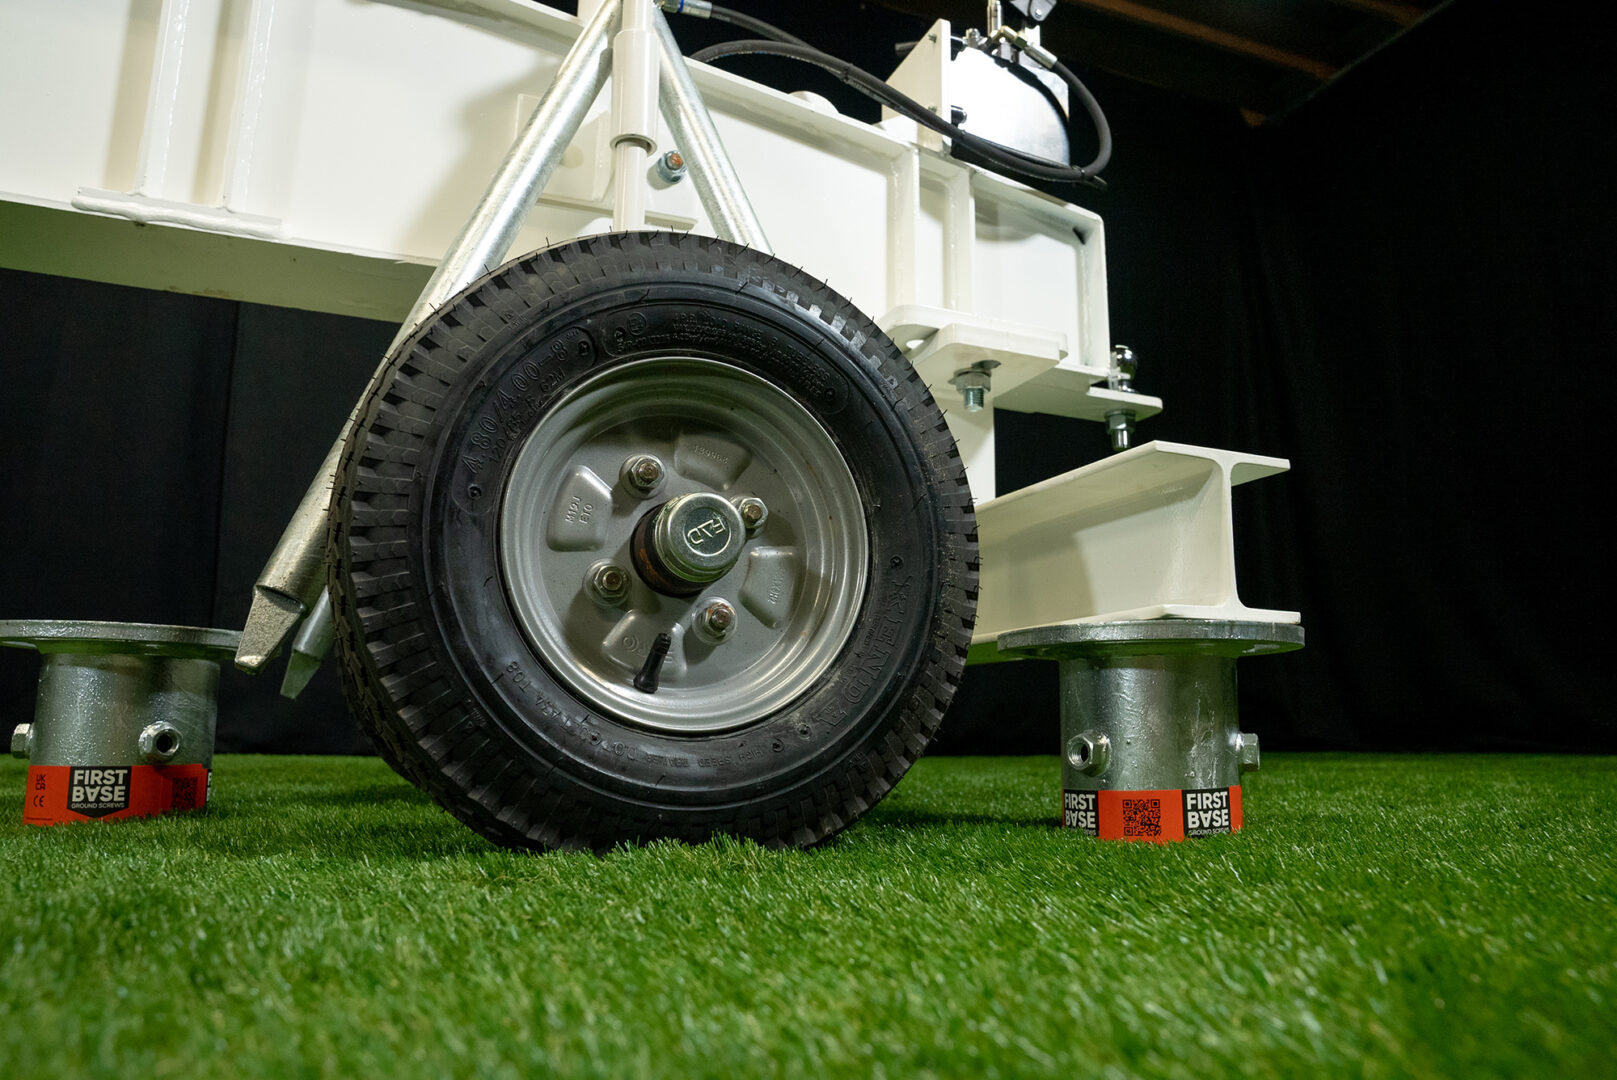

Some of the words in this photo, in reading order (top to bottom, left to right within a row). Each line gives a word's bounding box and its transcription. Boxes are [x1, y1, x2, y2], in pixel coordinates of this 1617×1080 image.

[815, 576, 913, 727] KENDA
[73, 769, 128, 785] FIRST
[71, 785, 126, 802] BASE
[1064, 793, 1096, 810] FIRST
[1186, 791, 1228, 810] FIRST
[1065, 810, 1096, 828] BASE
[1187, 809, 1230, 829] BASE
